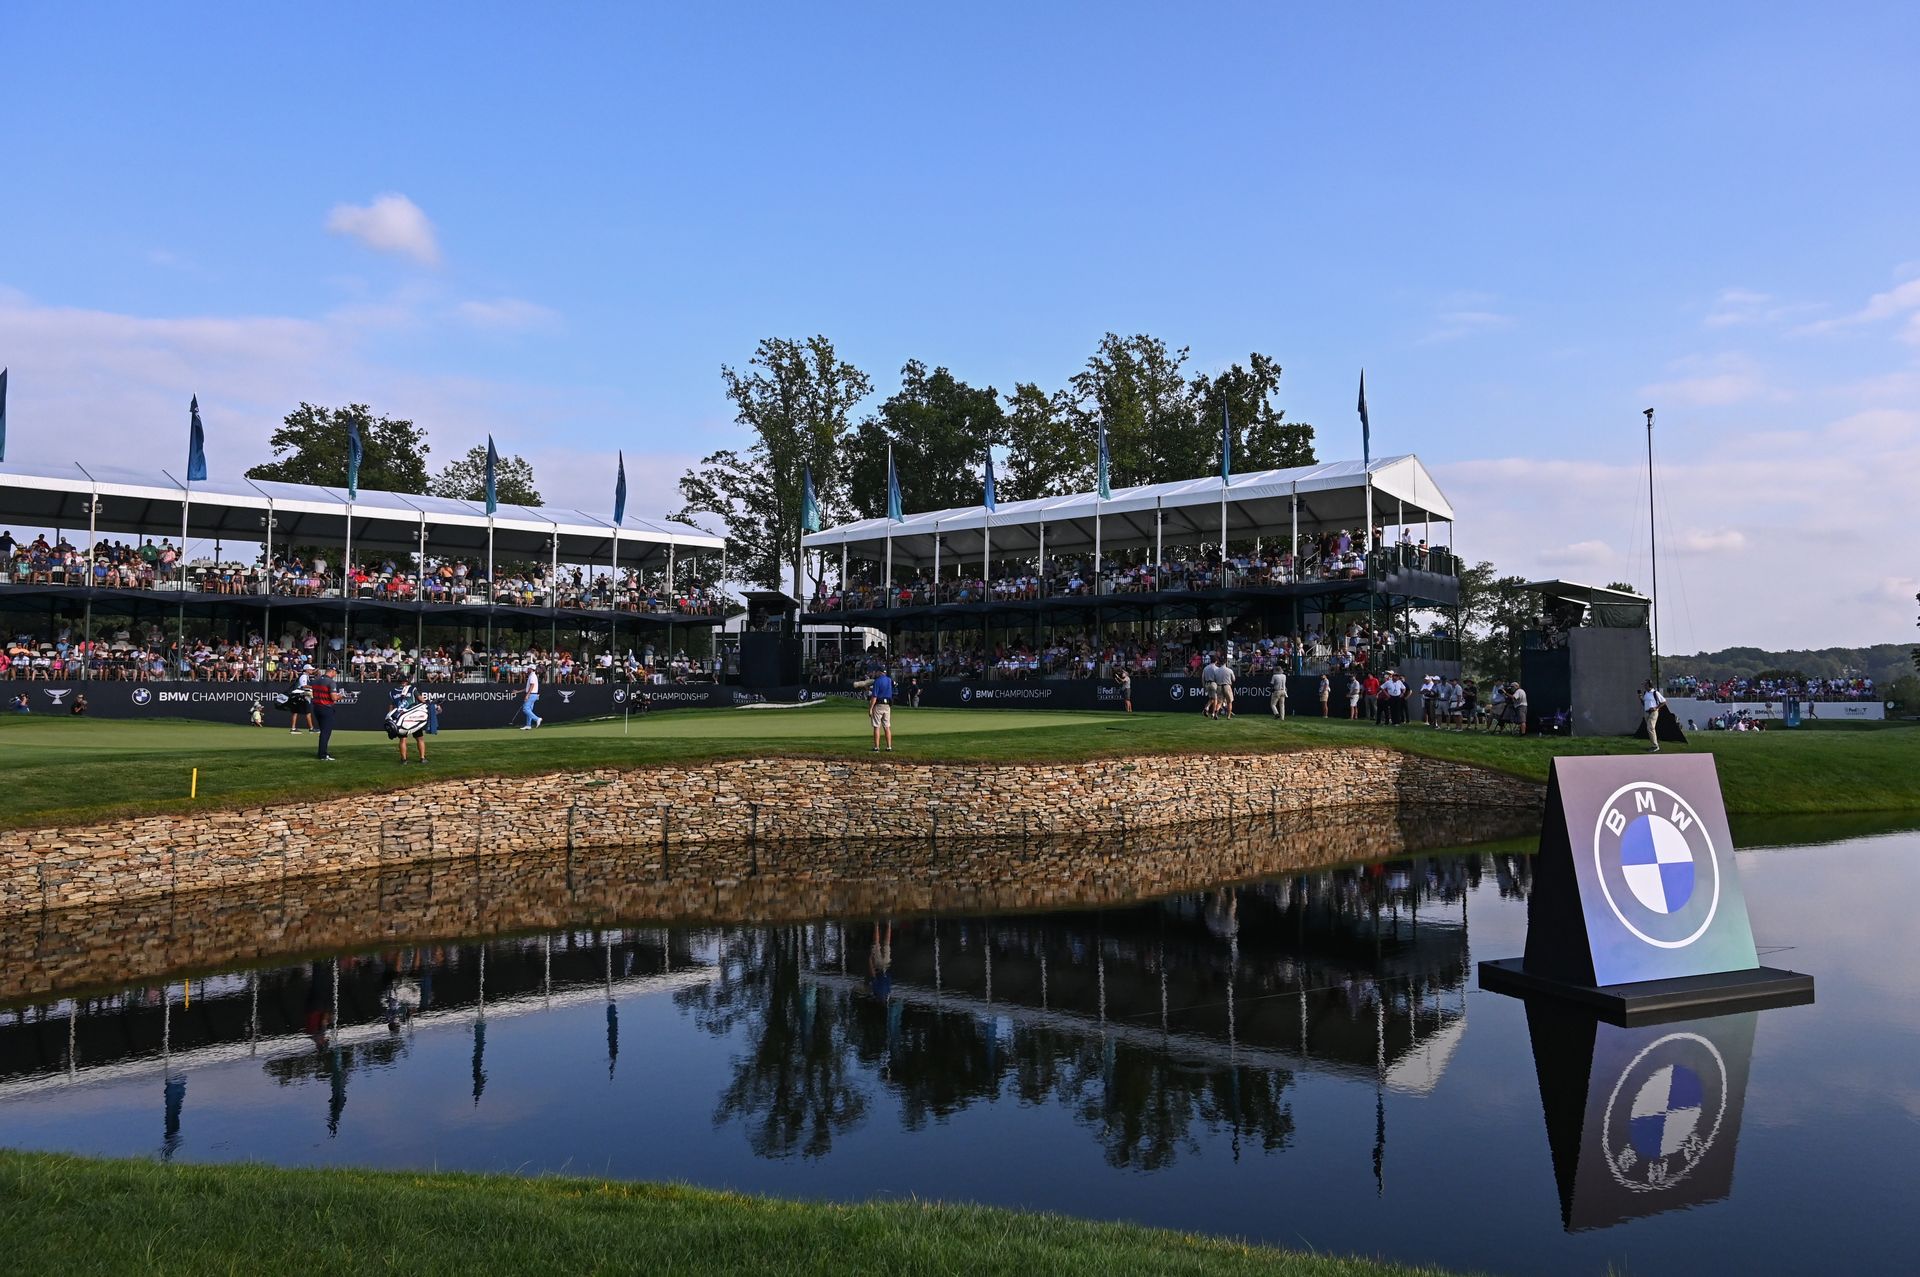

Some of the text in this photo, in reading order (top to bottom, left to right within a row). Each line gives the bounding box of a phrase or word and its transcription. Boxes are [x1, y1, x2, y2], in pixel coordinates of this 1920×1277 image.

[159, 691, 279, 702] BMW CHAMPIONSHIP
[421, 692, 446, 701] BMW
[447, 691, 517, 701] CHAMPIONSHIP
[630, 692, 710, 701] BW CHAMPIONSHIP
[811, 691, 827, 700] BMW
[976, 689, 1052, 698] BMW CHAMPIONSHIP
[1605, 790, 1693, 837] BMW
